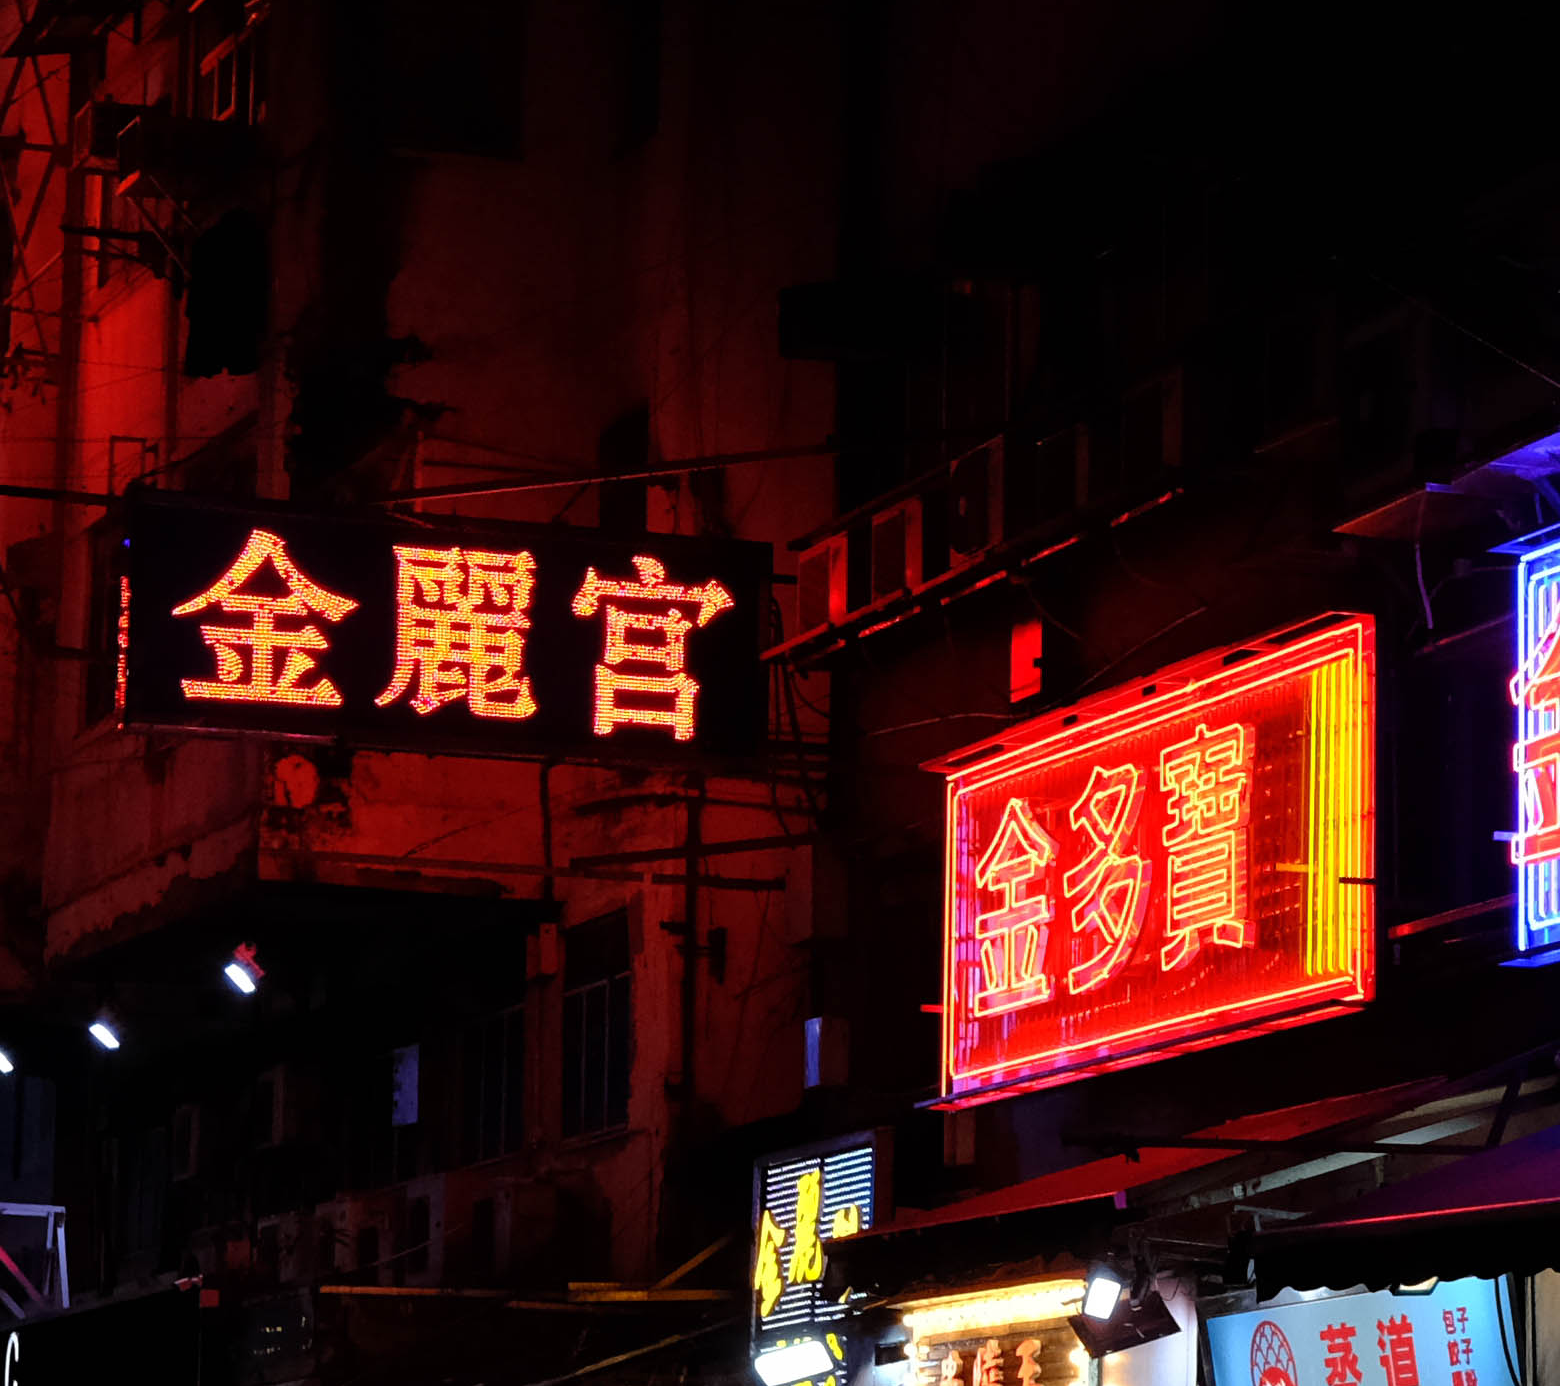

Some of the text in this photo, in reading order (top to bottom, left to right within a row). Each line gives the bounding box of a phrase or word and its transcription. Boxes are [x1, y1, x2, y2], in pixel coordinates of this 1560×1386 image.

[171, 529, 736, 743] 金麗宮
[970, 719, 1256, 1018] 金多寶
